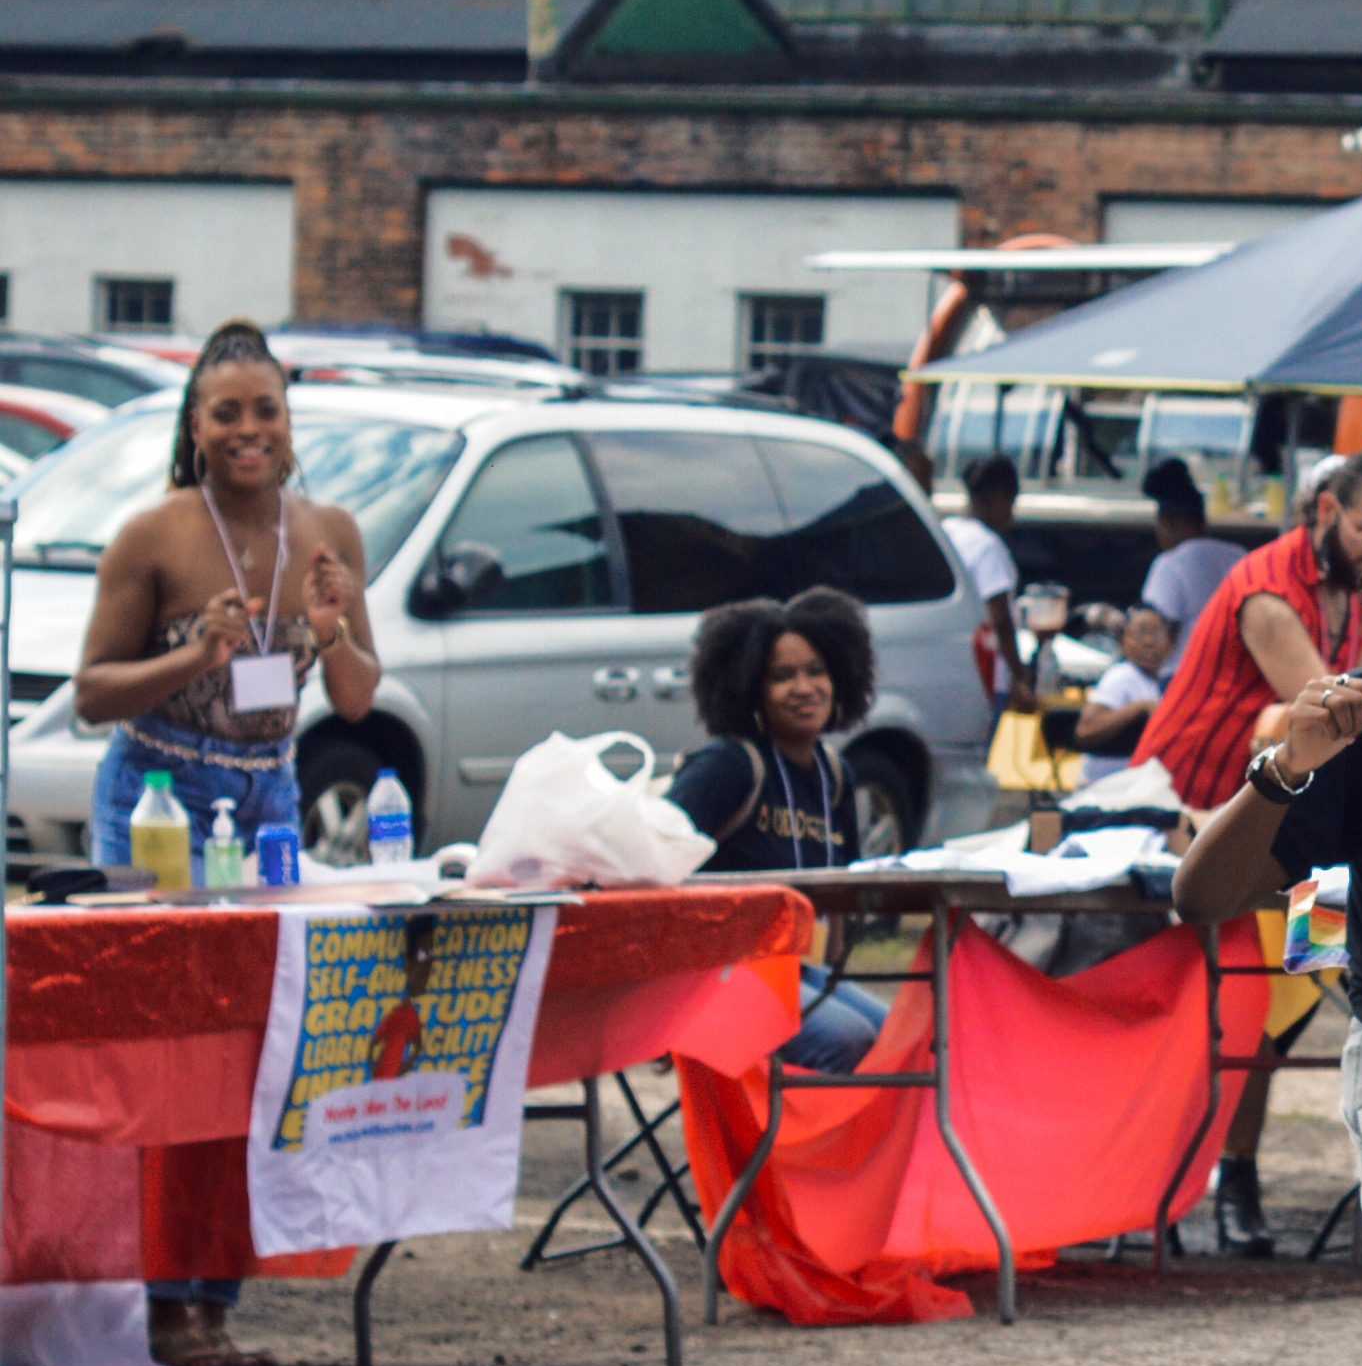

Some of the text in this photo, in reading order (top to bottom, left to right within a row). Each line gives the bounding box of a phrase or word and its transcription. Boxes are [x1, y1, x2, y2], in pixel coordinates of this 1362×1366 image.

[309, 923, 528, 963] COMMUCATION
[308, 956, 520, 999] SELF-AWRENESS
[305, 989, 508, 1034] GRATTUDE
